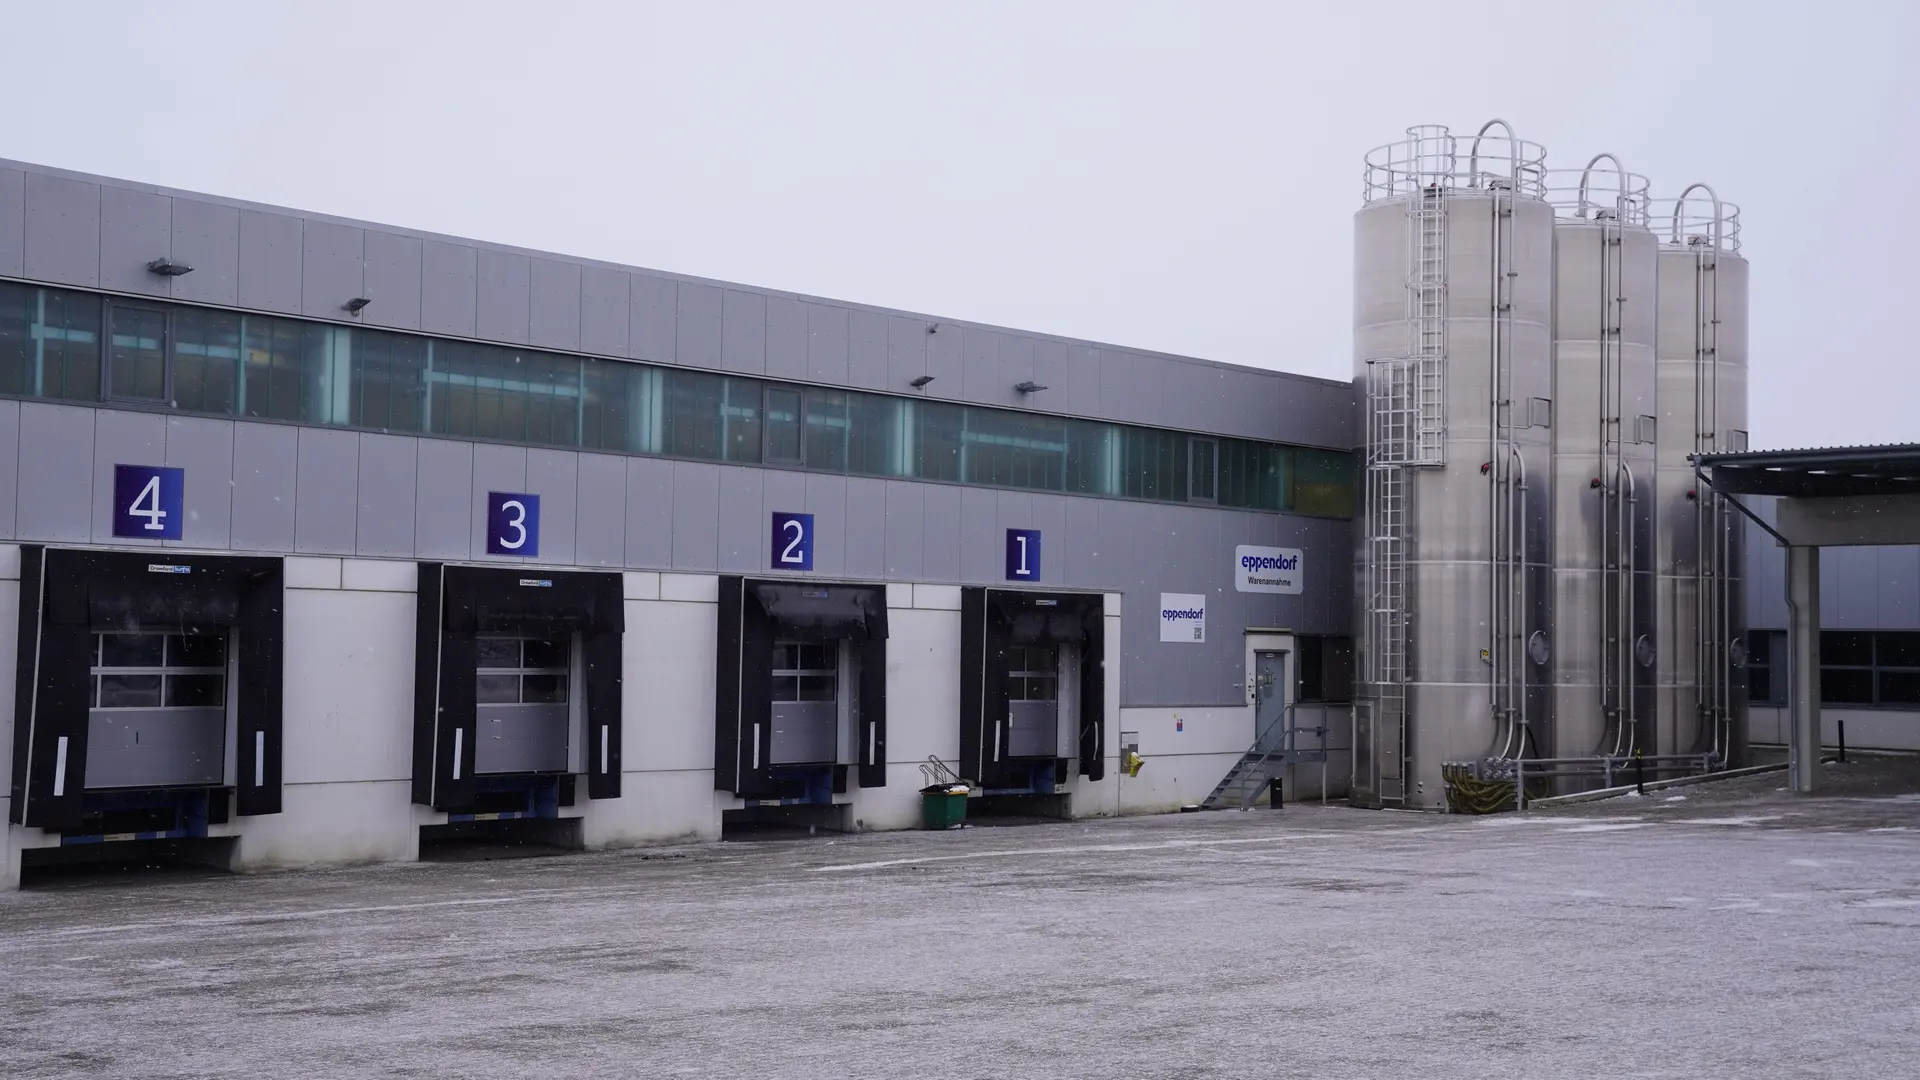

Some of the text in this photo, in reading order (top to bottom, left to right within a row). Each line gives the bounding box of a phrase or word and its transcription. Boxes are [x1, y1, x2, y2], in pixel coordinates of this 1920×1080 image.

[129, 475, 167, 530] 4
[500, 500, 526, 549] 3
[781, 520, 803, 563] 2
[1016, 536, 1030, 575] 1
[1241, 554, 1298, 572] eppendorf
[1247, 576, 1292, 587] Warenannahme
[1162, 607, 1204, 621] eppendorf
